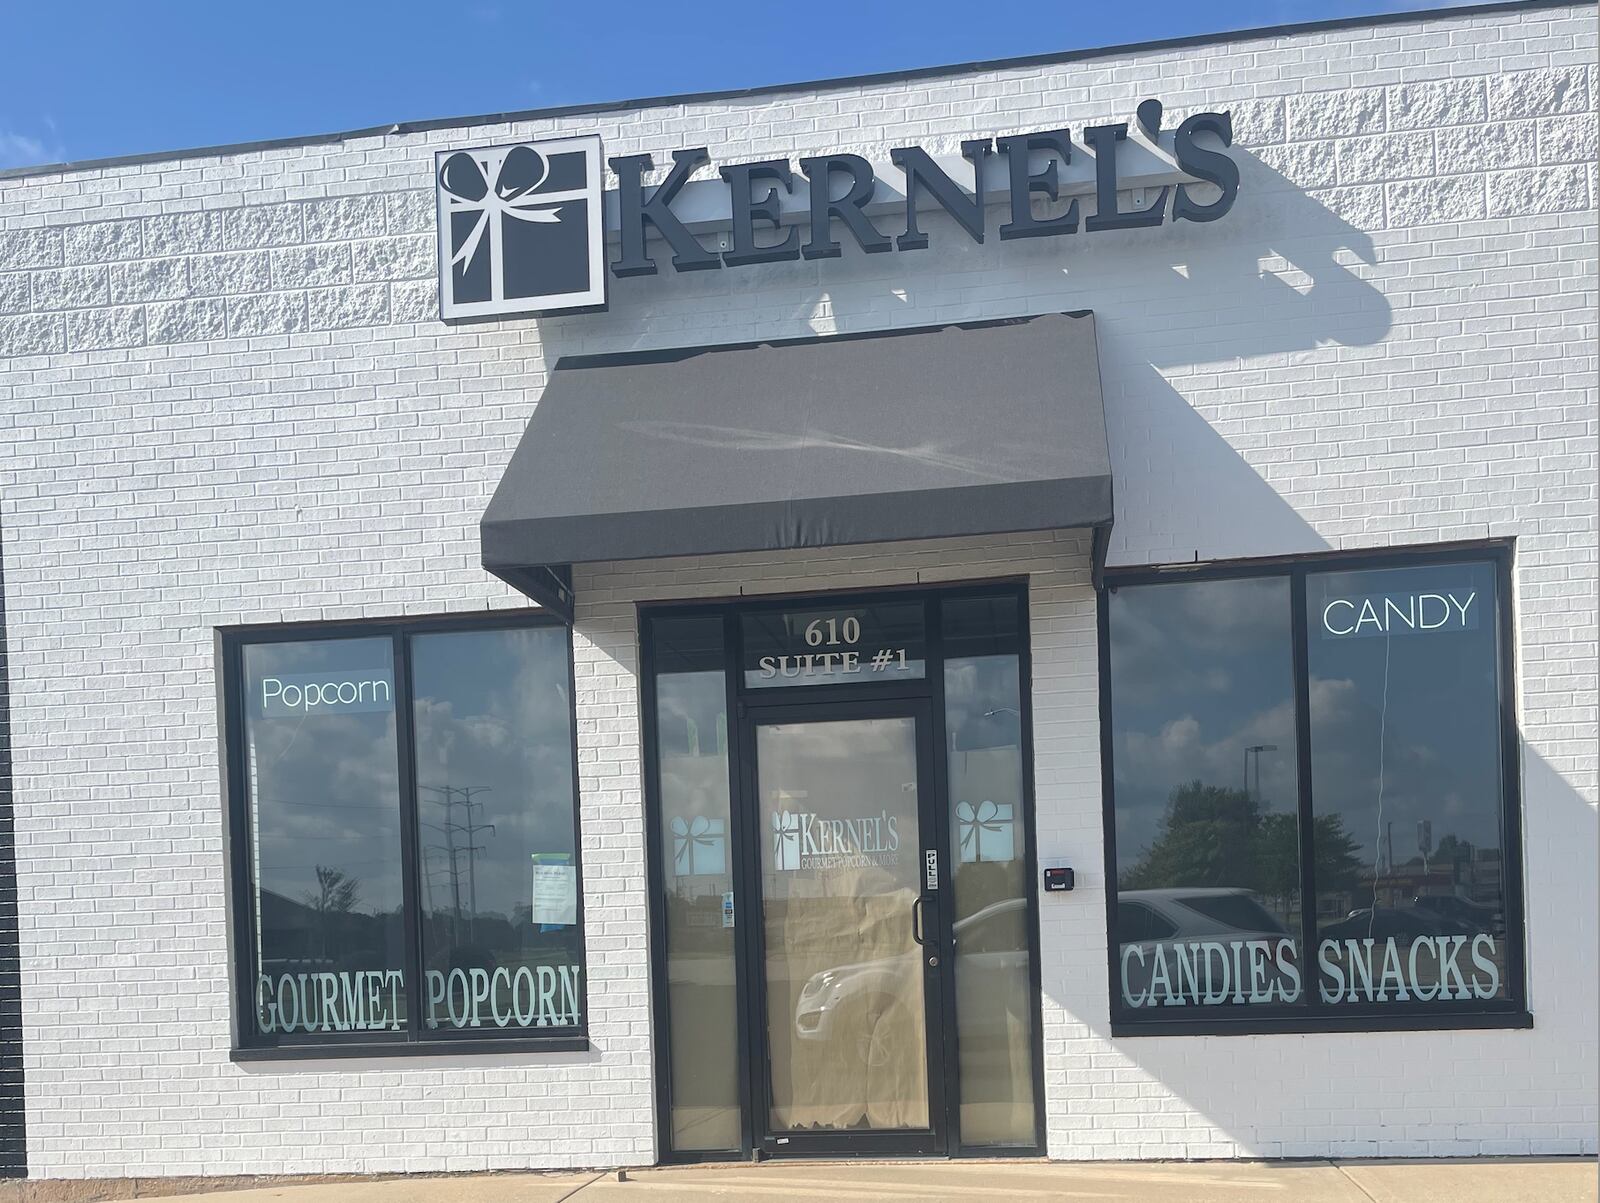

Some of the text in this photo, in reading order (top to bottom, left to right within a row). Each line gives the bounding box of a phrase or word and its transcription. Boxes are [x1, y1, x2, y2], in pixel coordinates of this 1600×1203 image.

[608, 99, 1240, 278] KERNEL'S
[805, 617, 860, 647] 610
[1323, 592, 1476, 635] CANDY
[759, 648, 909, 679] SUITE #1
[262, 677, 390, 712] Popcorn
[800, 809, 899, 856] KERNEL'S
[801, 856, 835, 870] GOURMET
[836, 854, 871, 869] POPCORN
[872, 855, 879, 866] &
[927, 853, 936, 877] PULL
[1121, 933, 1500, 1008] CANDIES SNACKS
[257, 965, 580, 1033] GOURMET POPCORN
